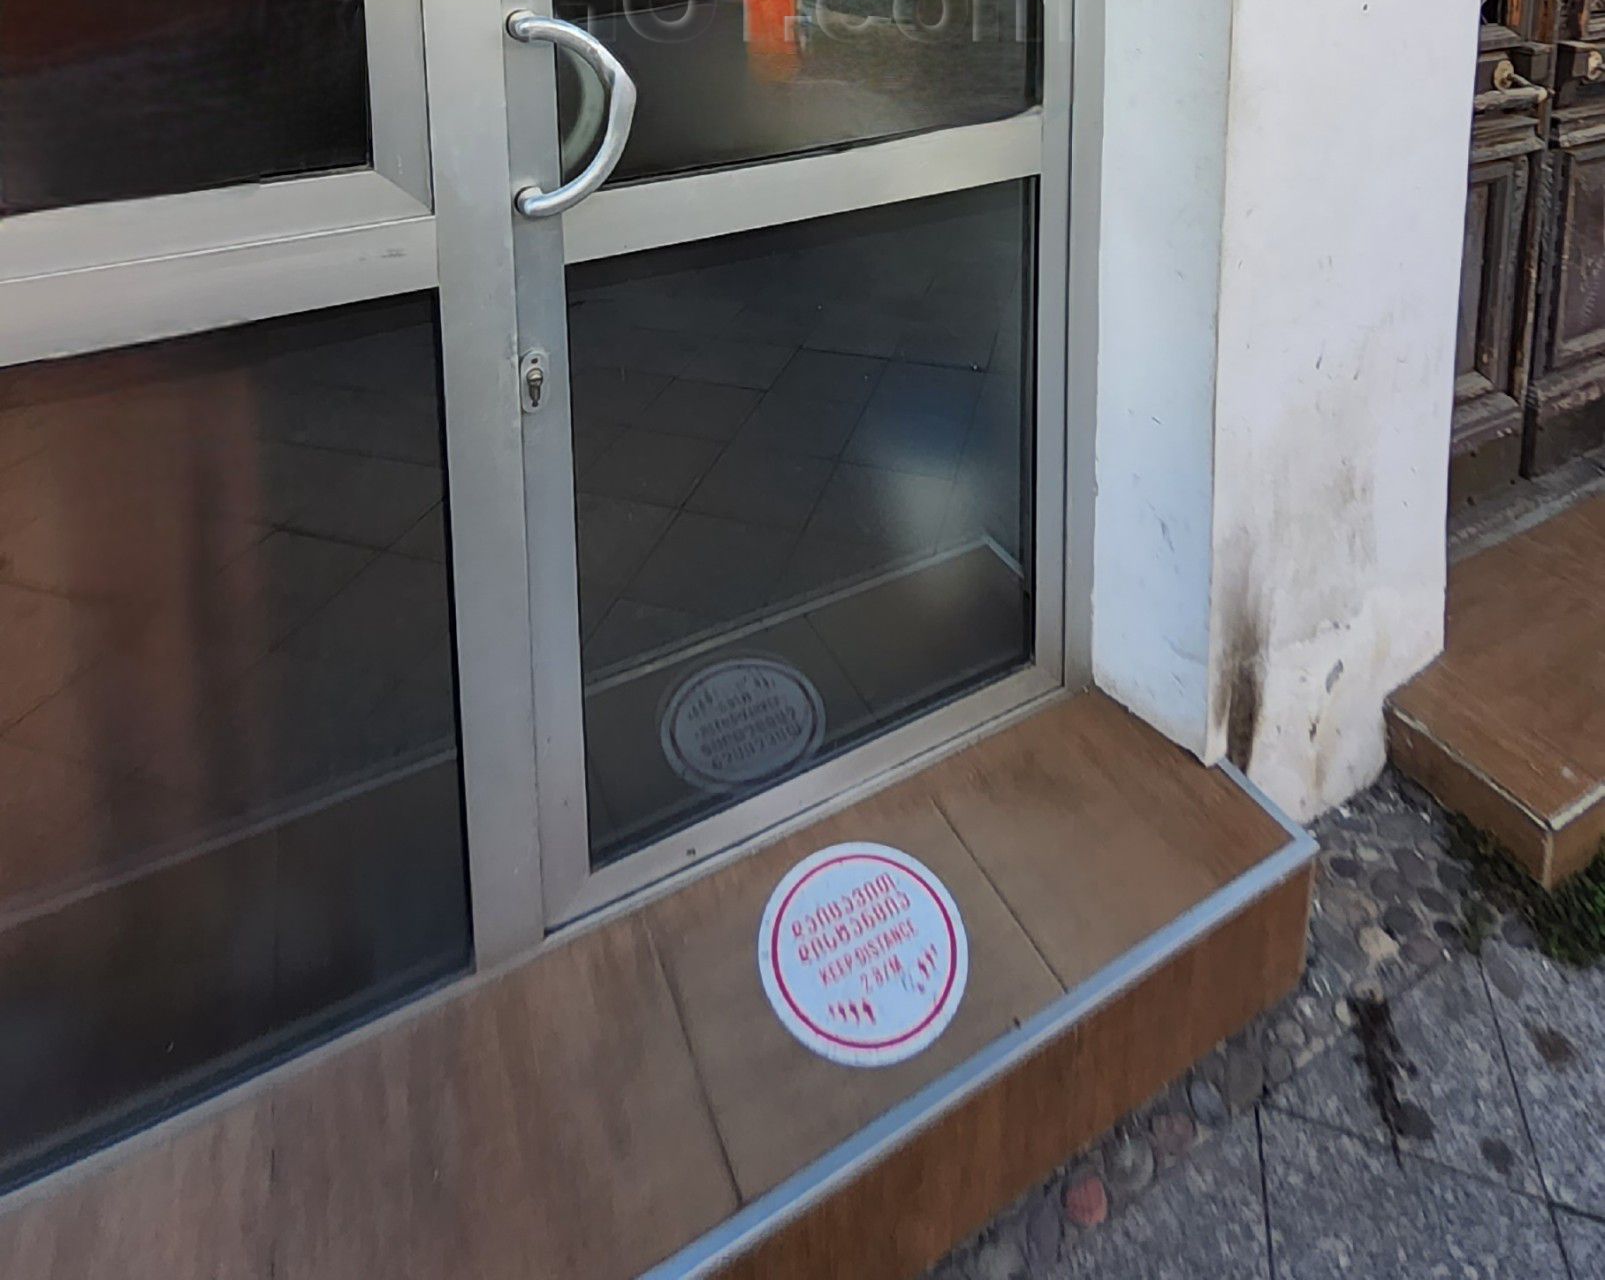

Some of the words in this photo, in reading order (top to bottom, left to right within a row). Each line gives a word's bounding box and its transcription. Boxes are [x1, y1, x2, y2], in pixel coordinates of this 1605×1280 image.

[791, 872, 898, 939] დაიცავით
[797, 891, 912, 965] დისტანცია
[818, 954, 856, 988] KEEP
[854, 917, 919, 968] DISTANCE
